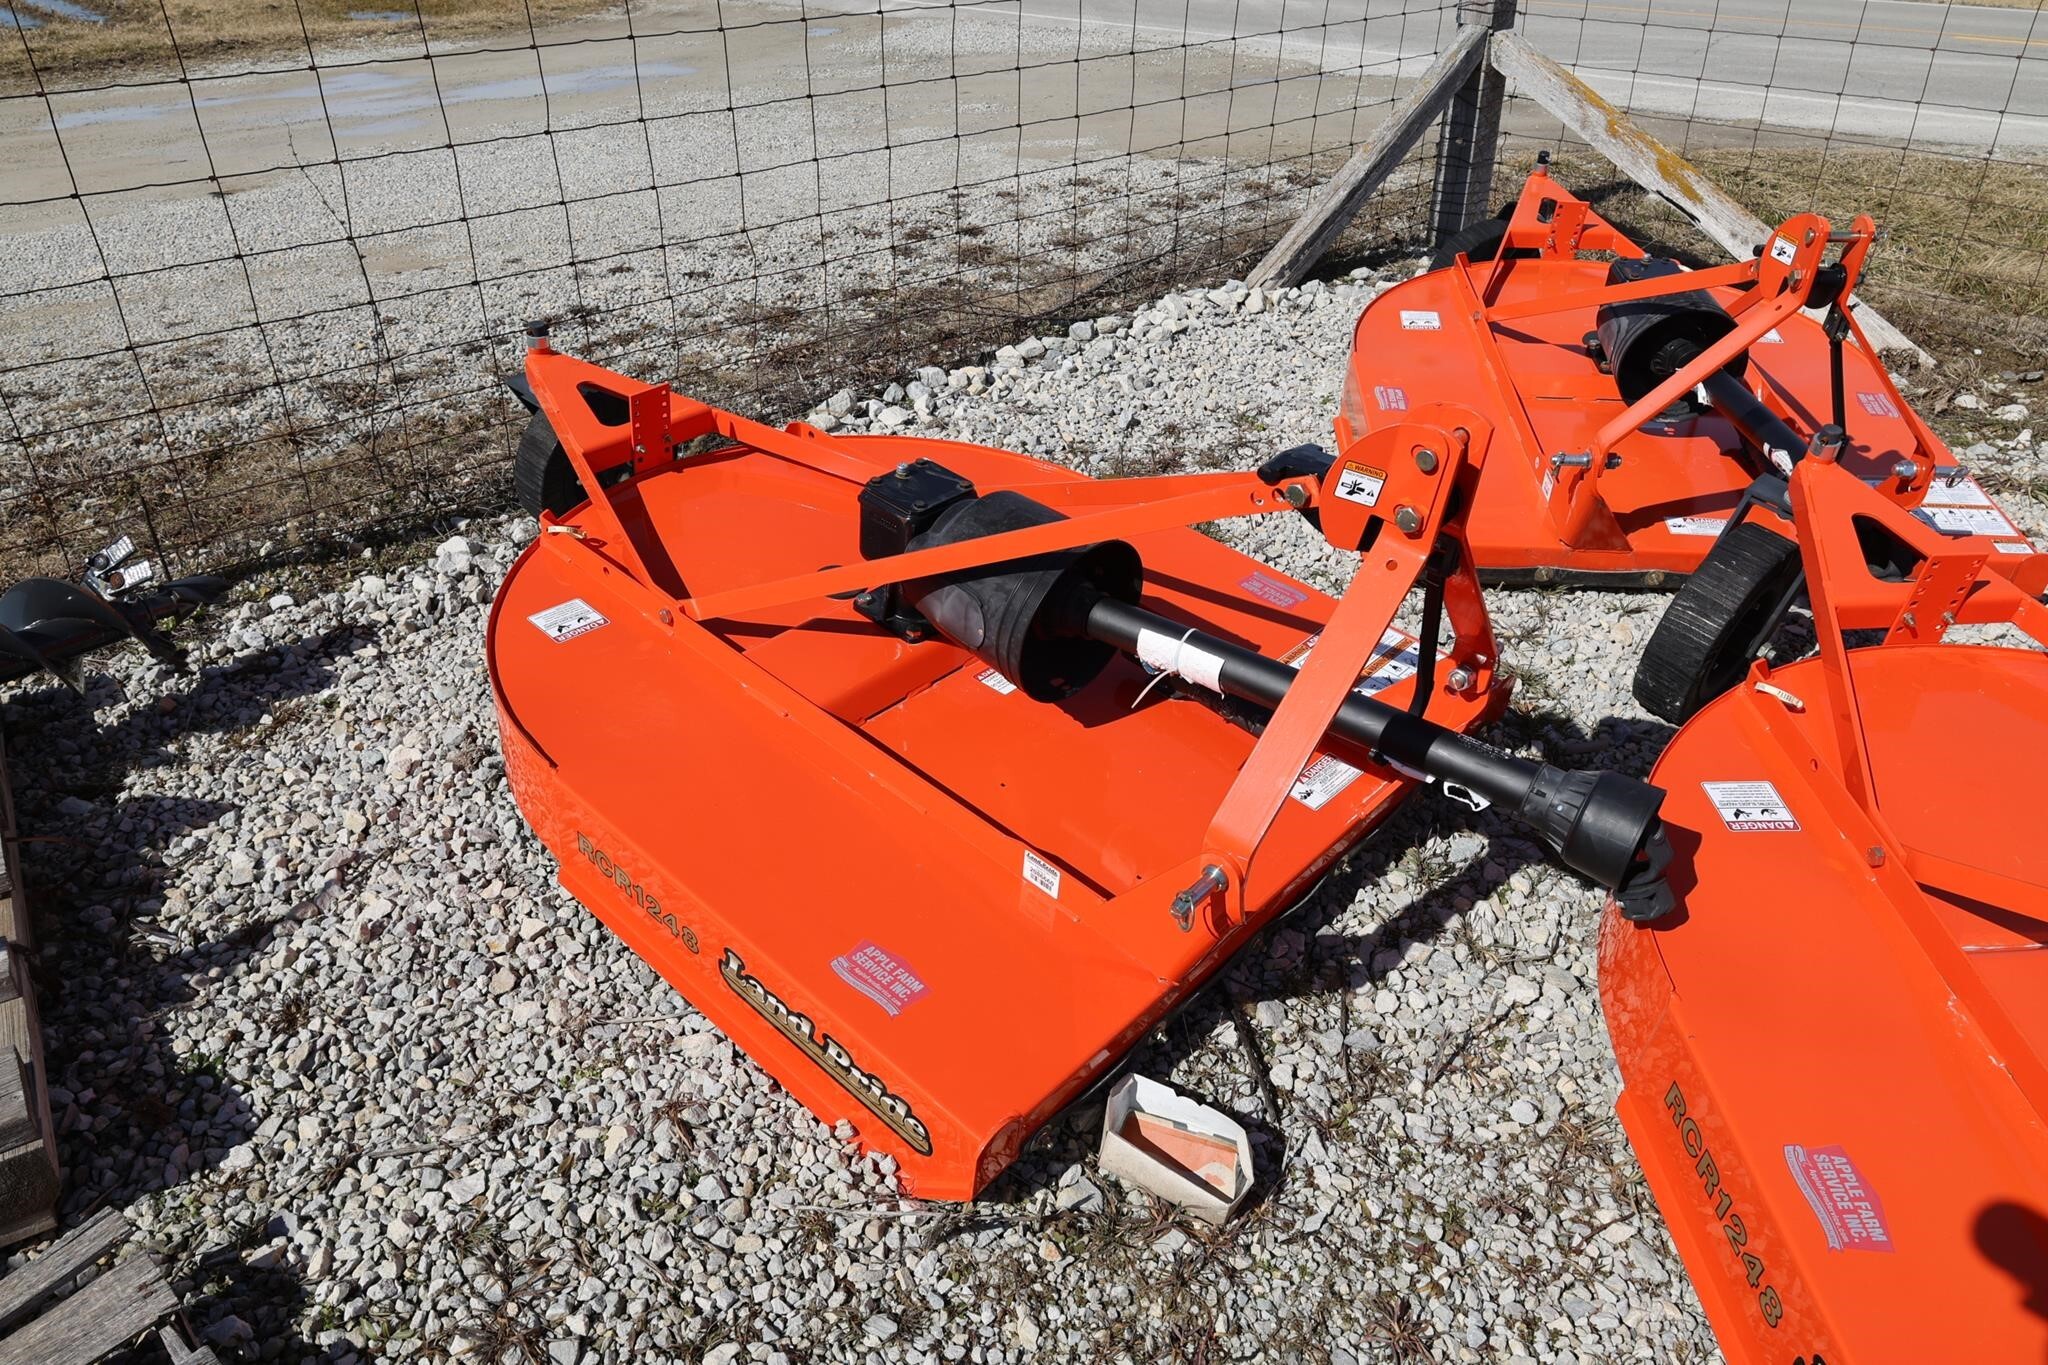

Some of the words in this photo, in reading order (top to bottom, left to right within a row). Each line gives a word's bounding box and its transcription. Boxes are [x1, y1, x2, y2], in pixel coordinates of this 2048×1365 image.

[1354, 464, 1384, 478] WARNING
[557, 621, 598, 641] DANGER
[1305, 755, 1335, 778] DANGER
[1730, 821, 1783, 830] DANGER
[577, 830, 699, 955] RCR1248
[852, 952, 894, 985] SERVICE
[889, 982, 911, 1002] INC.
[864, 946, 897, 971] APPLE
[892, 968, 924, 993] FARM
[724, 948, 814, 1044] Land
[823, 1035, 929, 1142] Pride
[1664, 1080, 1783, 1328] RCR1248
[1813, 1154, 1854, 1210] SERVICE
[1842, 1214, 1868, 1243] INC.
[1831, 1156, 1865, 1198] APPLE
[1854, 1202, 1888, 1242] FARM
